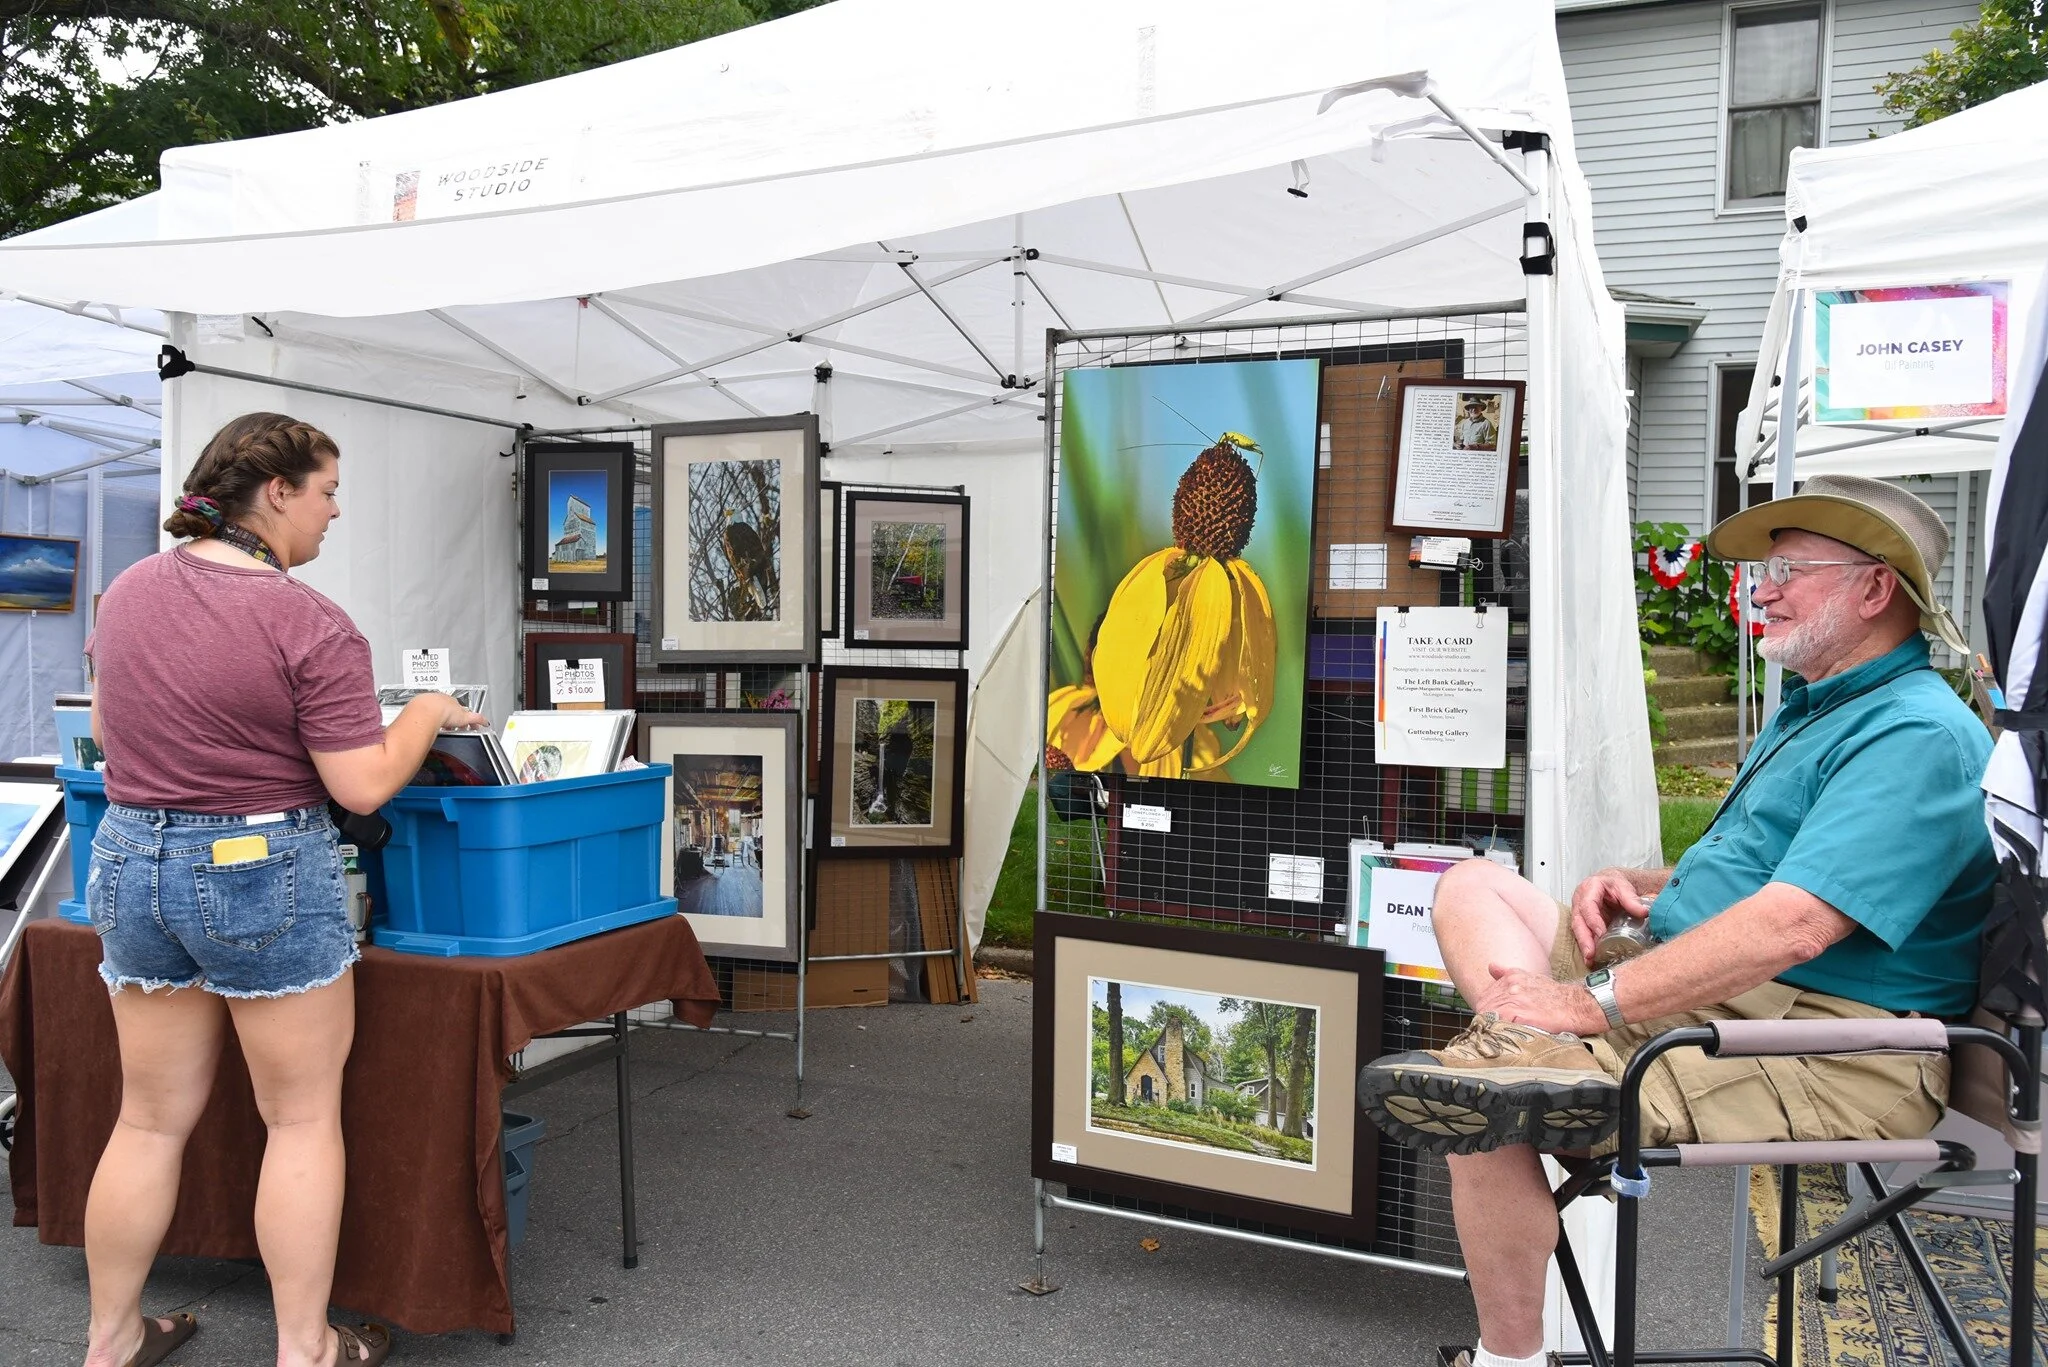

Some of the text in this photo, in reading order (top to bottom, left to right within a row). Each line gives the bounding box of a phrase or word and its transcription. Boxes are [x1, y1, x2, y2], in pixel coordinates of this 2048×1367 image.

[437, 157, 549, 187] WOODSIDE
[453, 178, 531, 202] STUDIO
[1856, 339, 1964, 356] JOHN CASEY
[1899, 360, 1935, 371] Painting
[1407, 637, 1473, 645] TAKE A CARD
[555, 664, 564, 695] SALE
[1450, 679, 1474, 687] Gallery
[1444, 707, 1468, 715] Gallery
[1407, 728, 1469, 737] Guttenberg Gallery
[1387, 902, 1424, 917] DEAN
